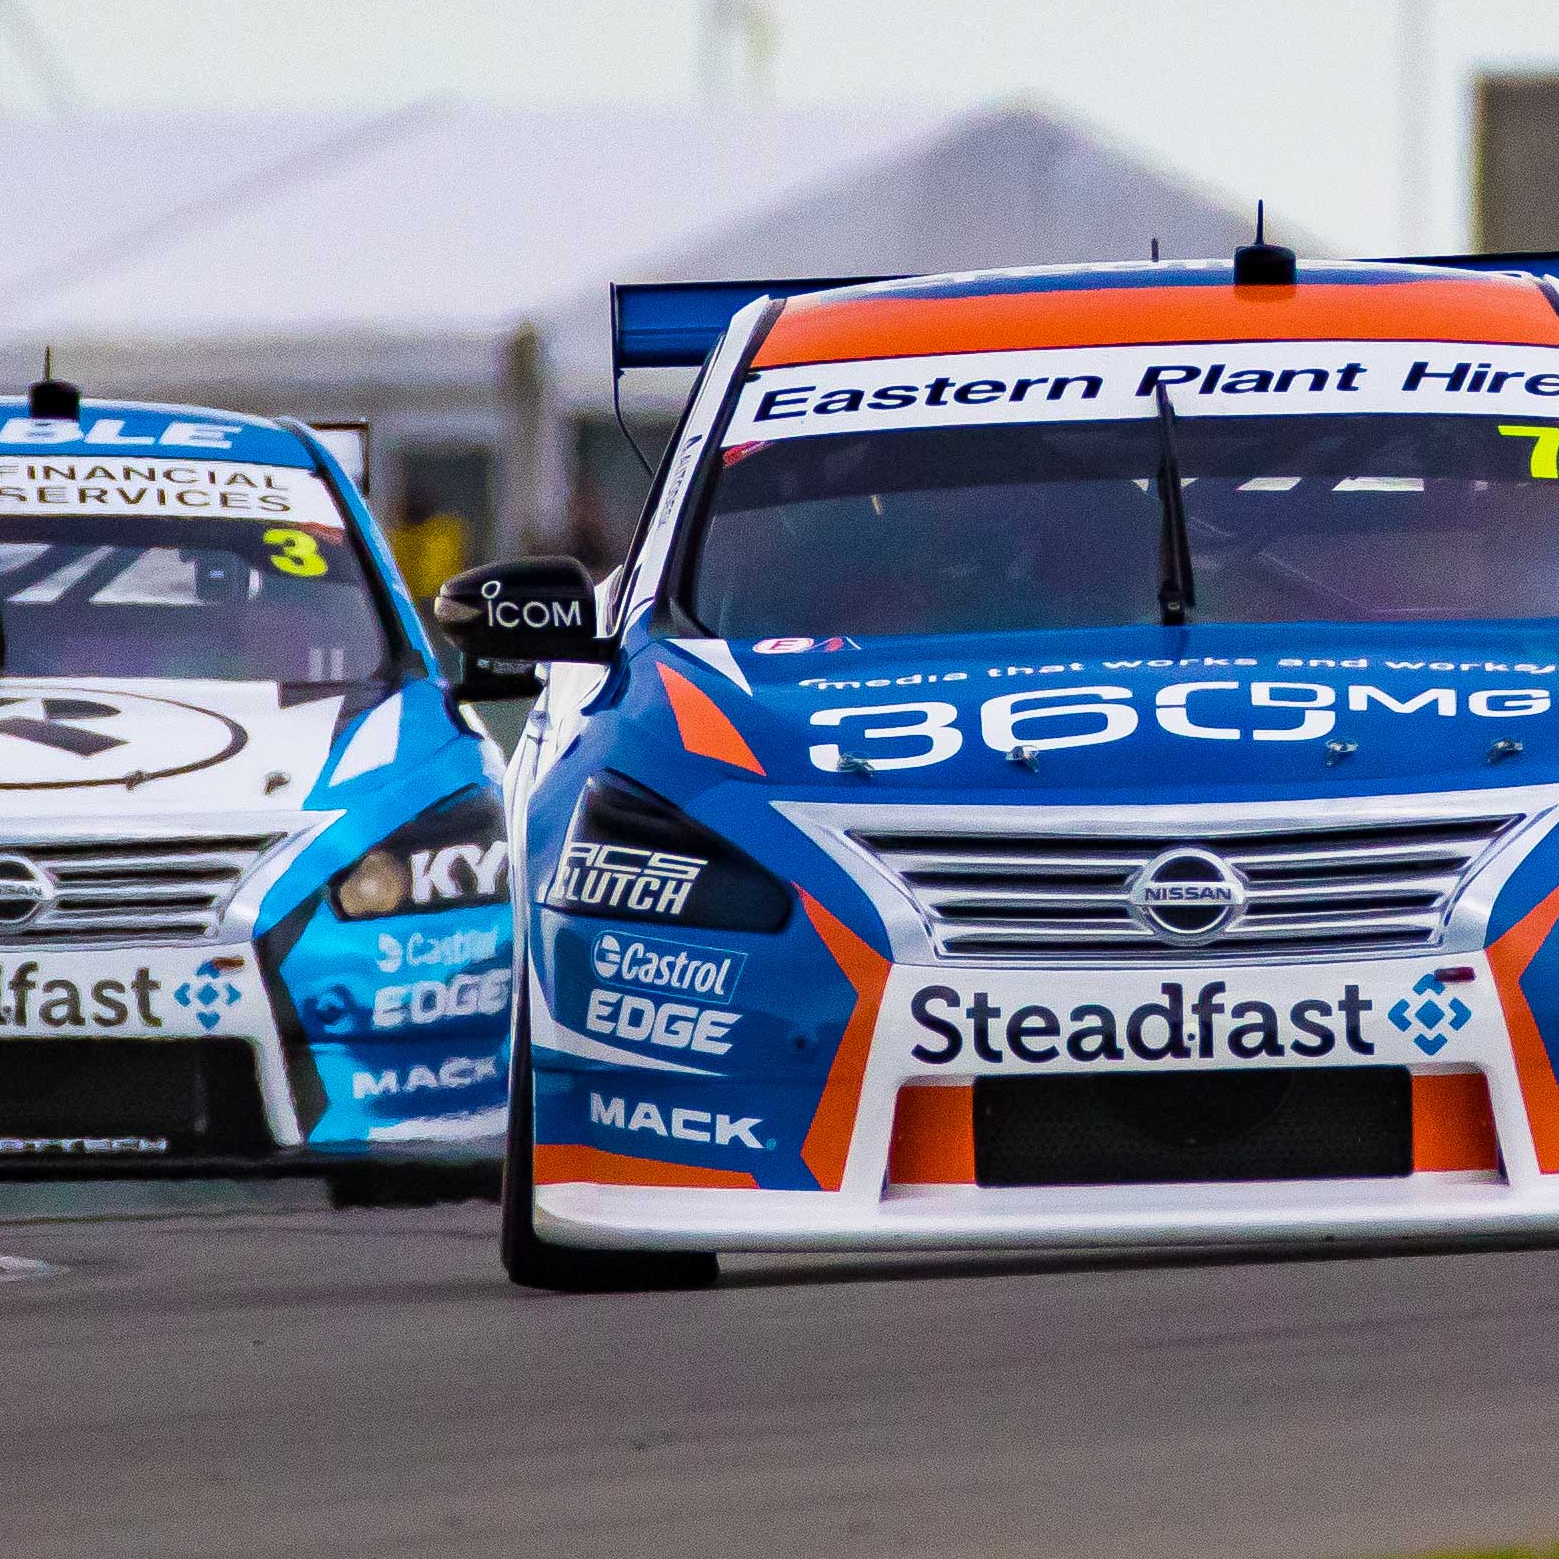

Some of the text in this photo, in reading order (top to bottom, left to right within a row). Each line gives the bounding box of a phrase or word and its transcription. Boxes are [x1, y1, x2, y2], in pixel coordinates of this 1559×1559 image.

[753, 374, 1104, 422] Eastern
[1138, 361, 1367, 398] Plant
[262, 528, 329, 578] 3
[818, 671, 968, 690] media
[987, 662, 1085, 678] that
[1101, 656, 1258, 669] works
[1278, 657, 1369, 669] and
[410, 841, 508, 904] KY
[562, 842, 709, 881] ACS
[1145, 887, 1231, 900] NISSAN
[621, 942, 731, 995] Castrol
[372, 968, 512, 1029] EDGE
[586, 988, 743, 1055] EDGE
[910, 980, 1375, 1066] Steadfast
[590, 1092, 767, 1148] MACK
